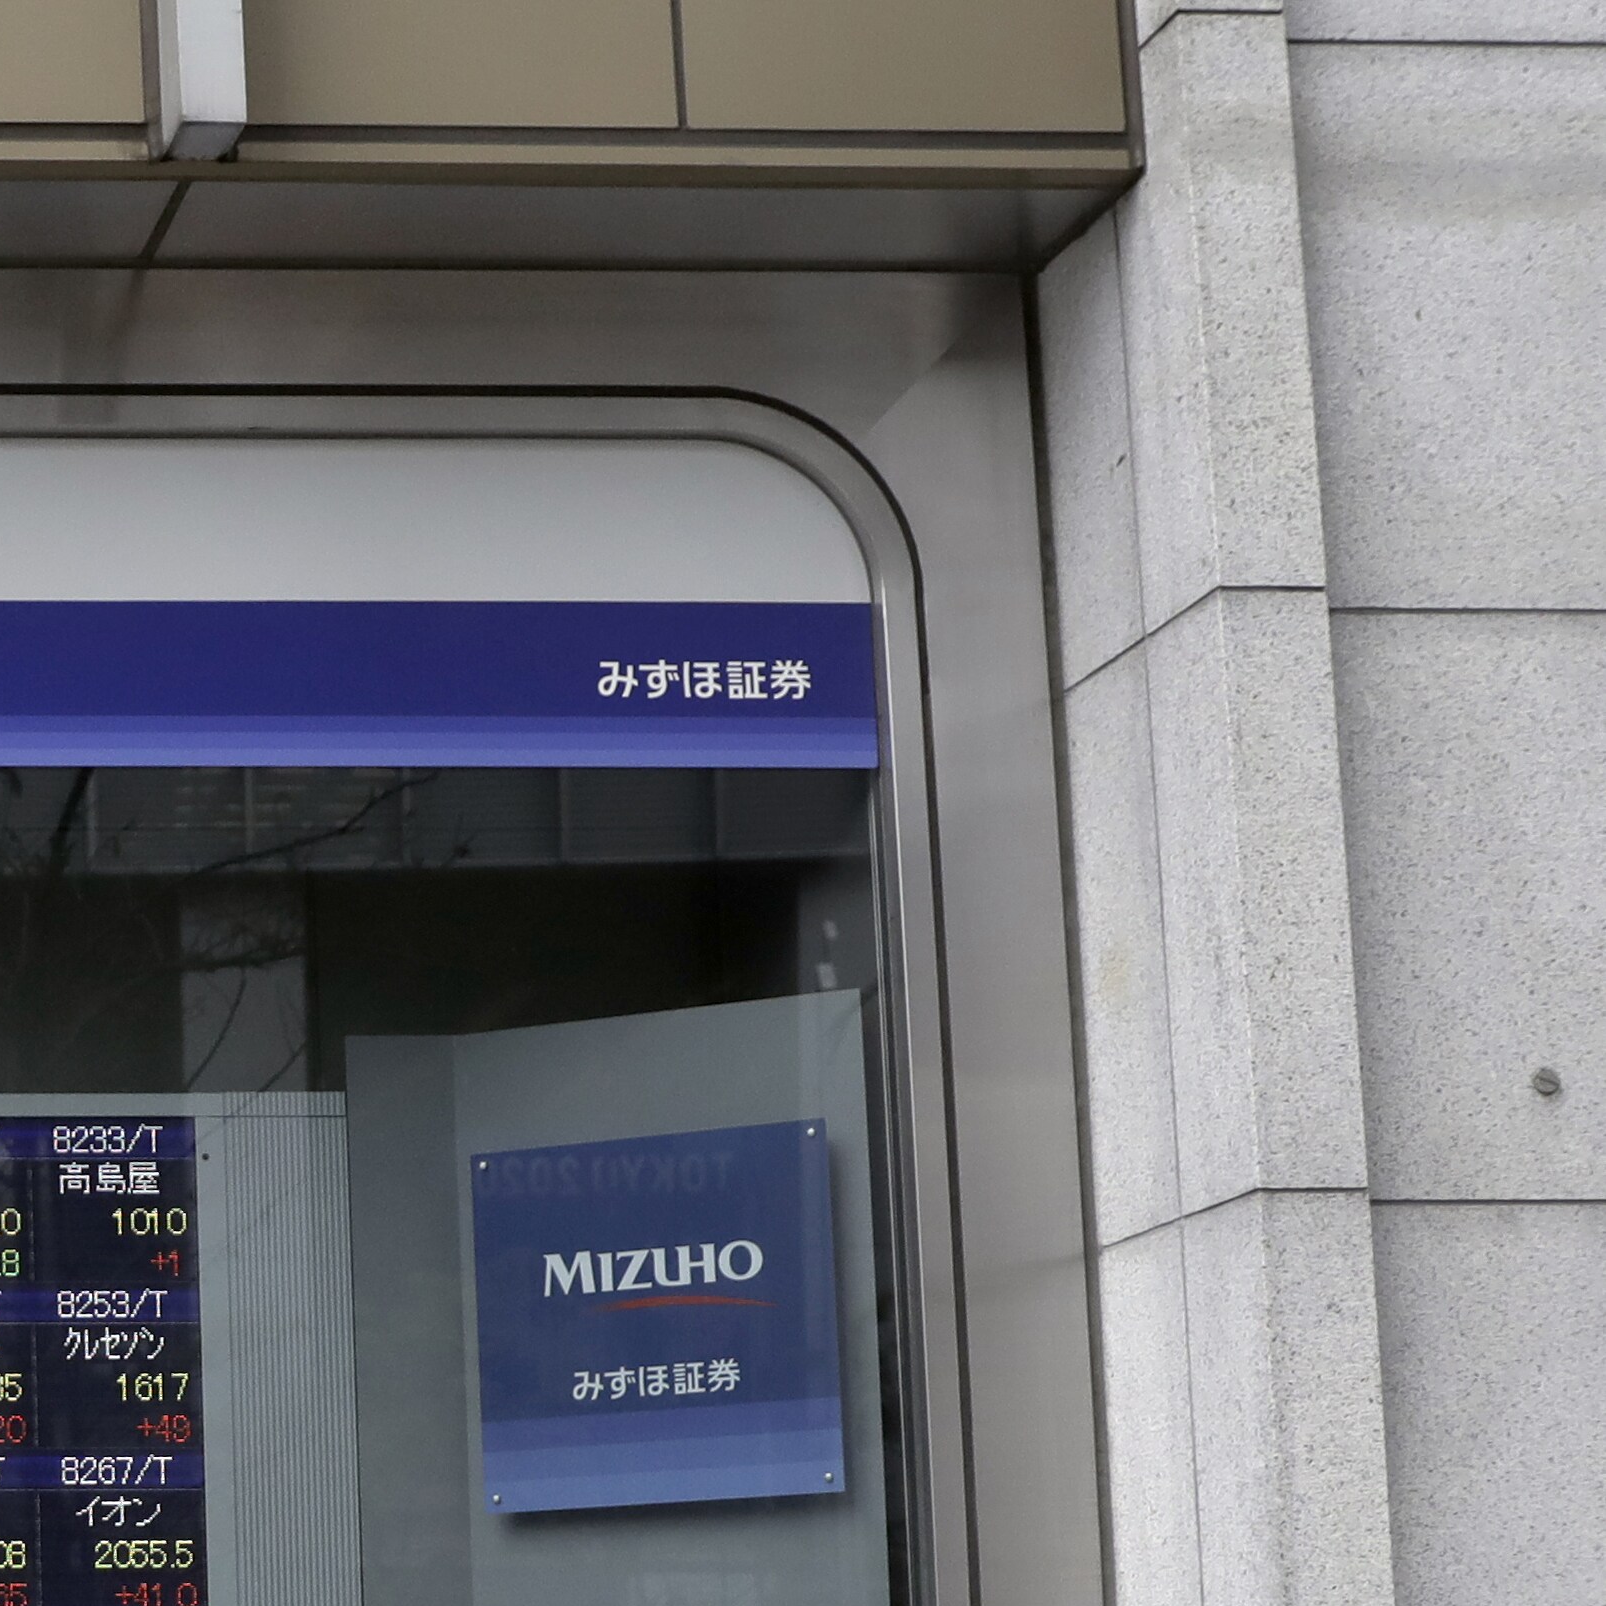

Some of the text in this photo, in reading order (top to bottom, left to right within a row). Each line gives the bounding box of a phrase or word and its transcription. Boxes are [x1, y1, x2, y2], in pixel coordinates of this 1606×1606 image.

[597, 659, 812, 700] みずほ証券
[52, 1122, 164, 1154] 8233/T
[59, 1161, 160, 1195] 高島屋
[542, 1239, 764, 1297] MIZUHO
[571, 1357, 742, 1401] みずほ証券
[75, 1495, 162, 1527] イオン
